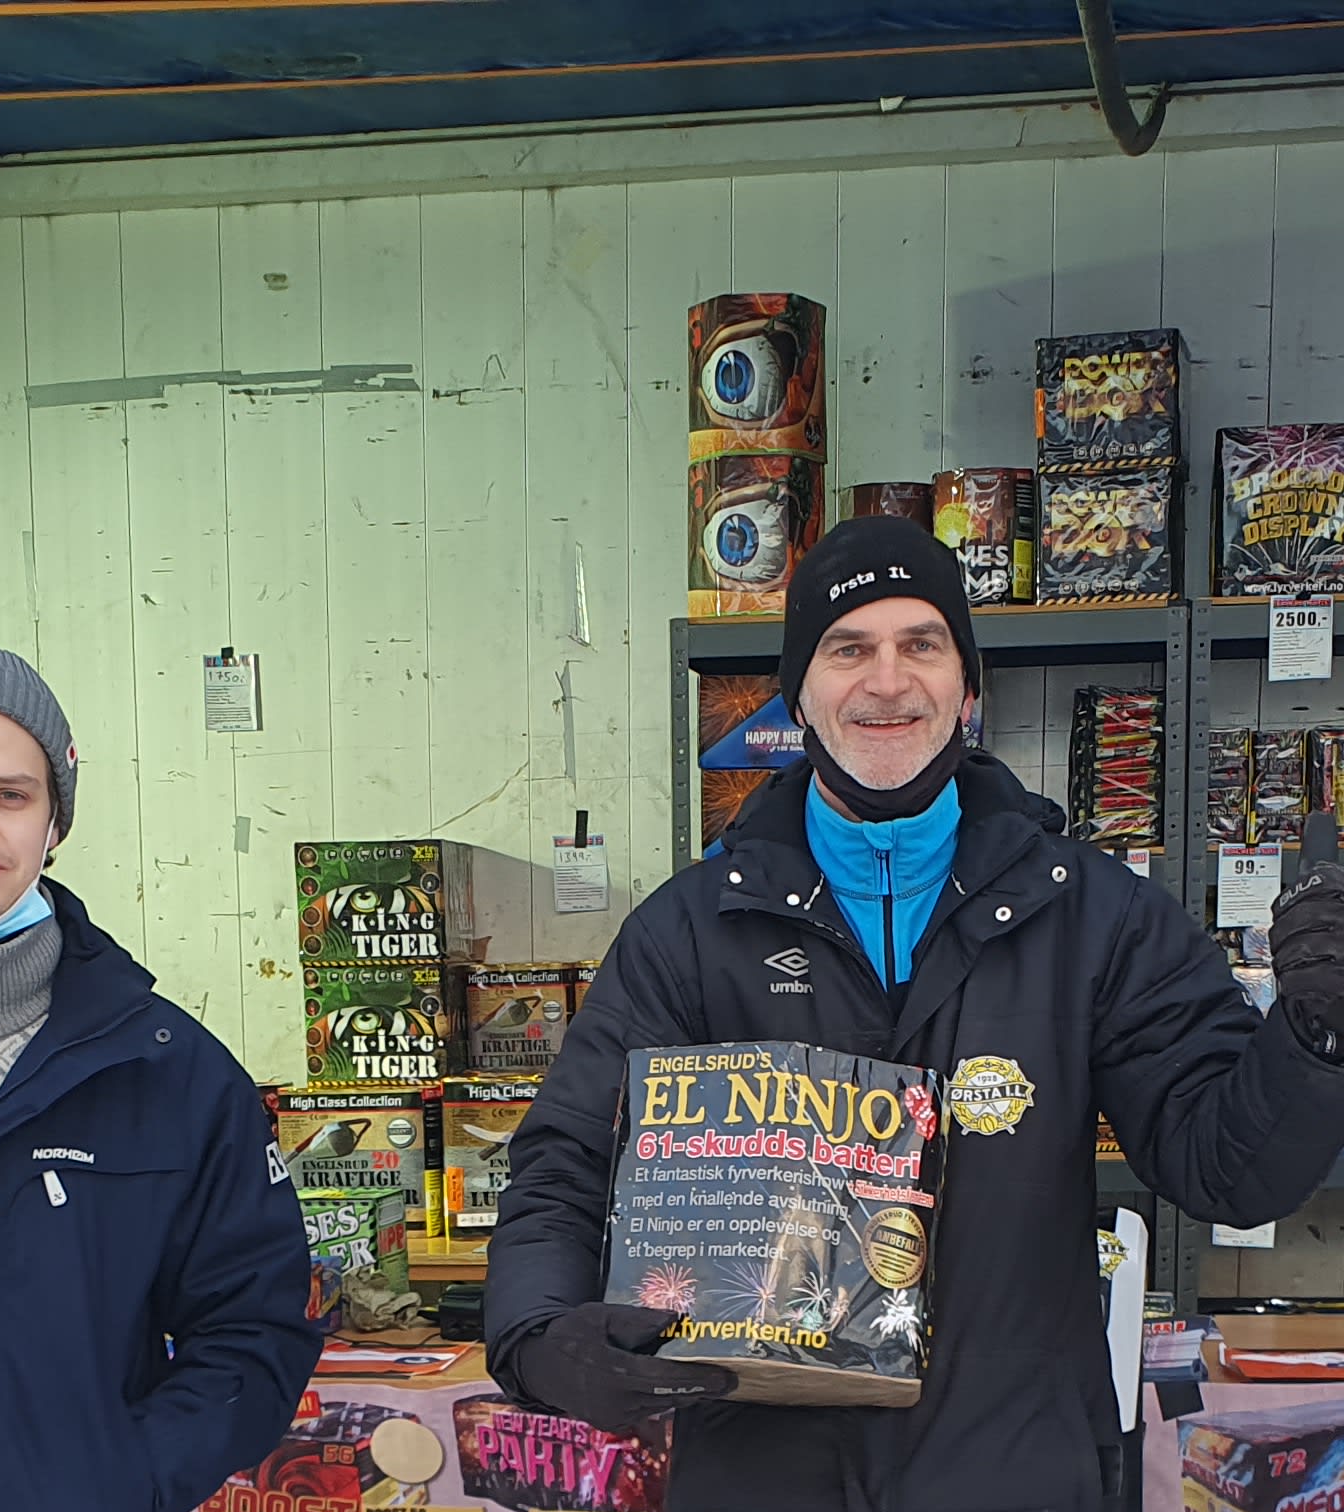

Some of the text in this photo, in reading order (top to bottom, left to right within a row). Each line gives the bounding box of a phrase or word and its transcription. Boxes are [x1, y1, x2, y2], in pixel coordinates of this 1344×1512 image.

[829, 566, 912, 601] Ørsta IL
[1275, 611, 1329, 628] 2500,-
[745, 731, 780, 746] HAPPY
[1234, 859, 1266, 876] 99,-
[1279, 874, 1323, 908] BULA
[351, 933, 440, 959] TIGER
[352, 1055, 439, 1078] TIGER
[649, 1052, 772, 1074] ENGELSRUD'S
[290, 1095, 402, 1110] High Class Collection
[469, 1086, 499, 1099] High
[951, 1086, 1001, 1102] ØRSTA
[639, 1071, 902, 1145] EL NINJO
[372, 1151, 400, 1169] 20
[636, 1128, 922, 1179] 61-skudds batteri
[303, 1170, 401, 1187] KRAFTIGE
[634, 1165, 846, 1191] Et fantastisk fyrverkerishow
[632, 1190, 852, 1222] med en knallende avslutning.
[630, 1217, 841, 1246] El Ninjo er en opplevelse og
[644, 1242, 696, 1260] begrep
[659, 1316, 828, 1350] w.fyrverkeri.no
[322, 1444, 355, 1465] 56
[476, 1424, 623, 1506] PARTY
[1268, 1448, 1308, 1478] 72
